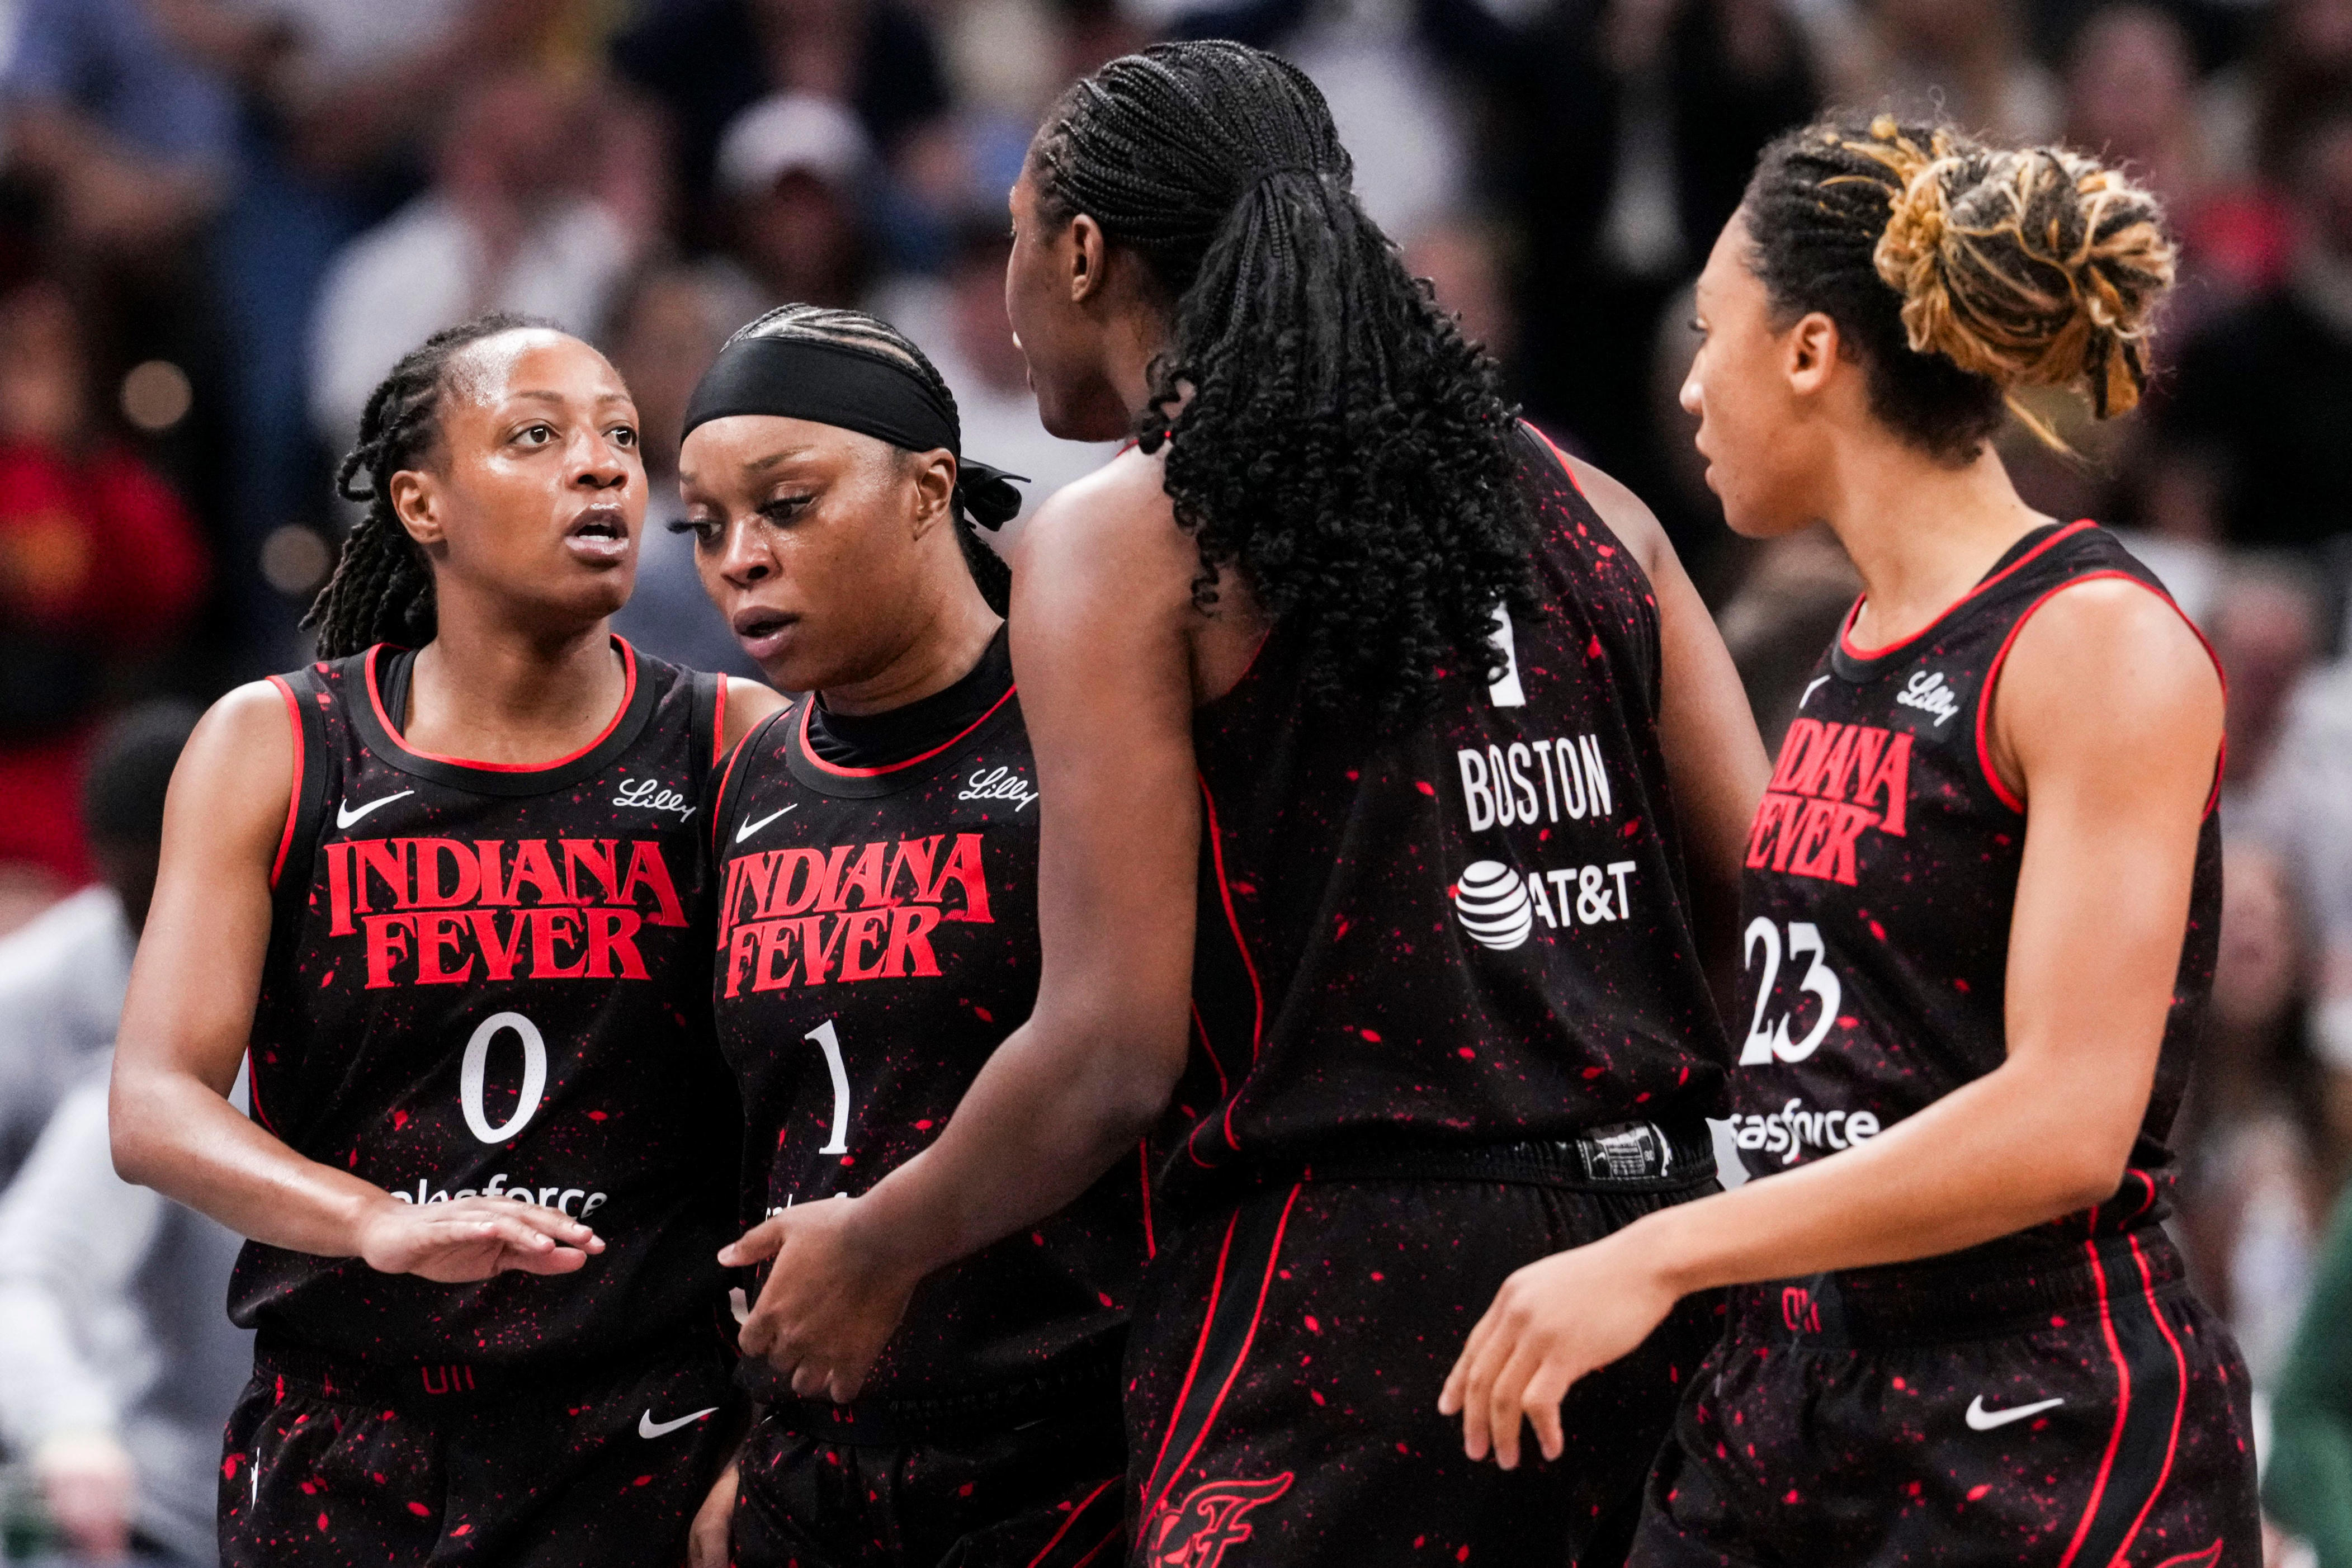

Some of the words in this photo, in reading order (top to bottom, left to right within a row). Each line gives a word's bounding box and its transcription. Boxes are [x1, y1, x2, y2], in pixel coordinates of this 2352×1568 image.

[1896, 670, 1959, 728] Lilly
[612, 778, 696, 823] Lilly
[958, 766, 1039, 813] Lilly
[1457, 734, 1612, 832] BOSTON
[1768, 717, 1915, 837] DIANA
[323, 836, 690, 938] INDIANA
[1745, 792, 1871, 887] EVER
[717, 833, 996, 951] INDIANA
[1527, 861, 1637, 929] AT&T
[361, 907, 652, 990] FEVER
[723, 905, 943, 999] FEVER
[1738, 916, 1841, 1066] 23
[460, 1012, 547, 1144] 0
[804, 1019, 850, 1155] 1
